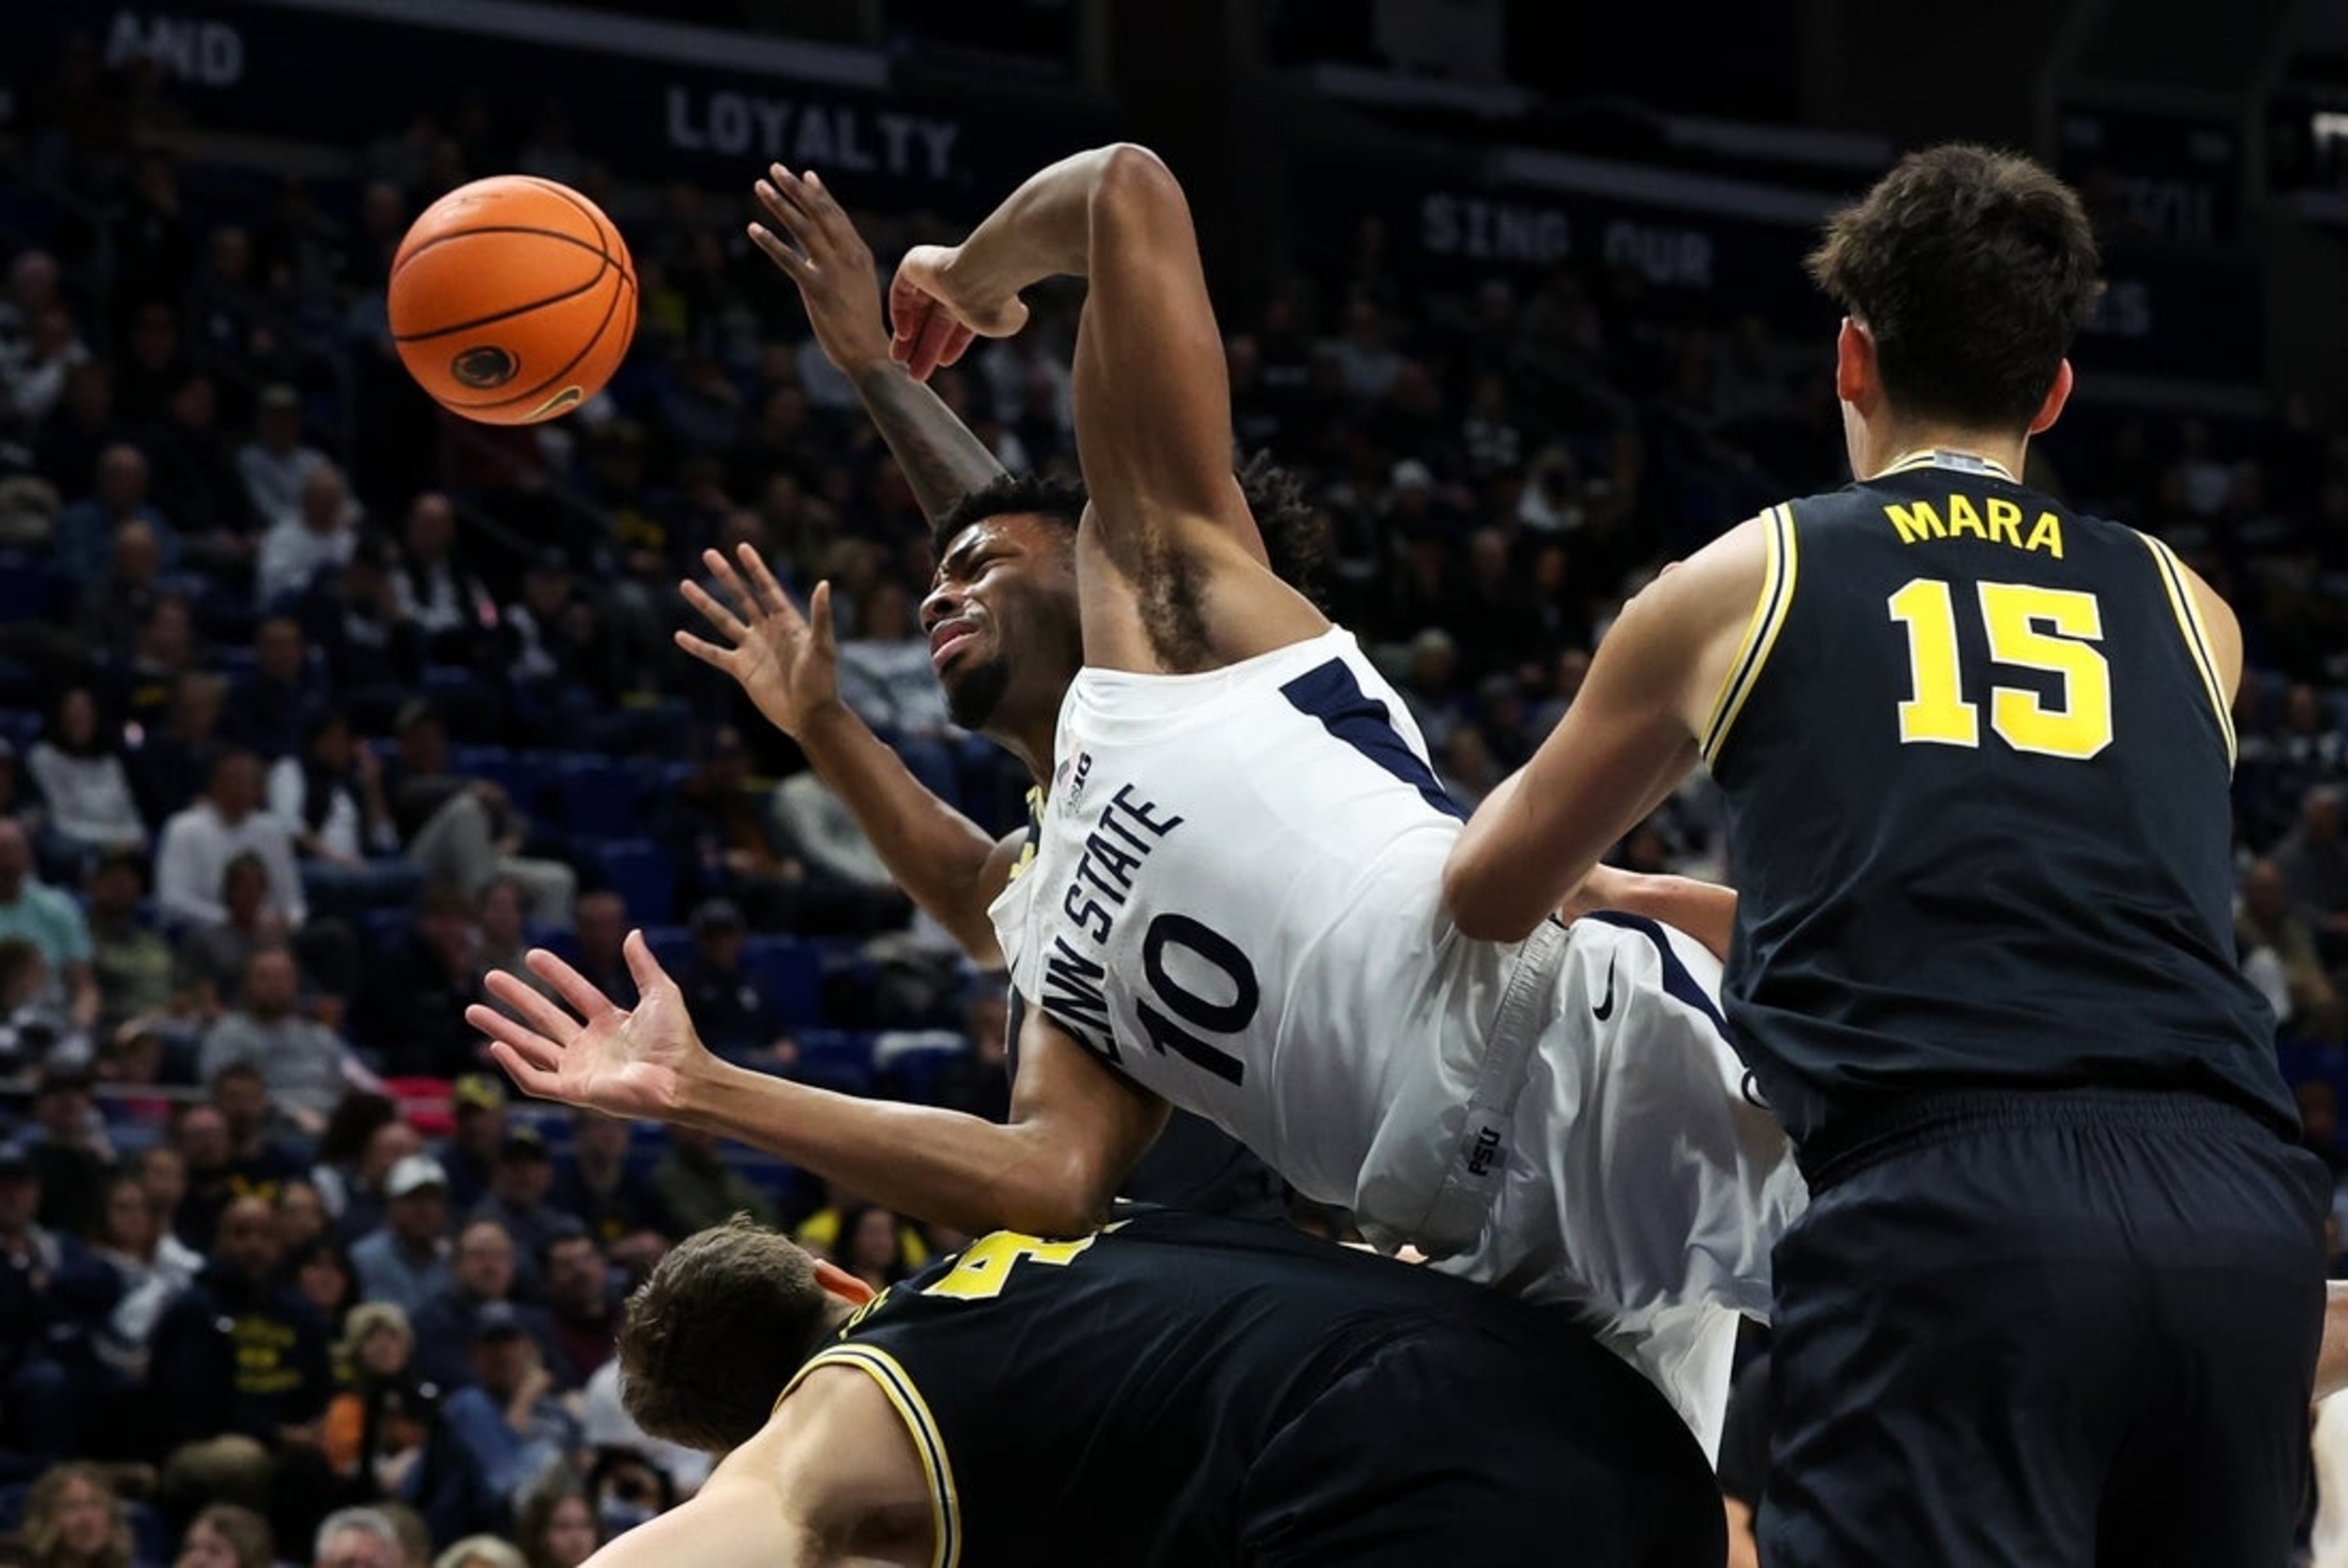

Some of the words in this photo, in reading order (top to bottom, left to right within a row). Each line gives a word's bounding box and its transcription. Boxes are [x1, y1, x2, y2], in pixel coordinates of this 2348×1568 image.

[1419, 191, 1571, 265] SING
[1883, 493, 2064, 560] MARA
[1887, 577, 2114, 761] 15
[1065, 784, 1183, 944] STATE
[1137, 913, 1259, 1086] 10
[1468, 1126, 1501, 1176] PSU
